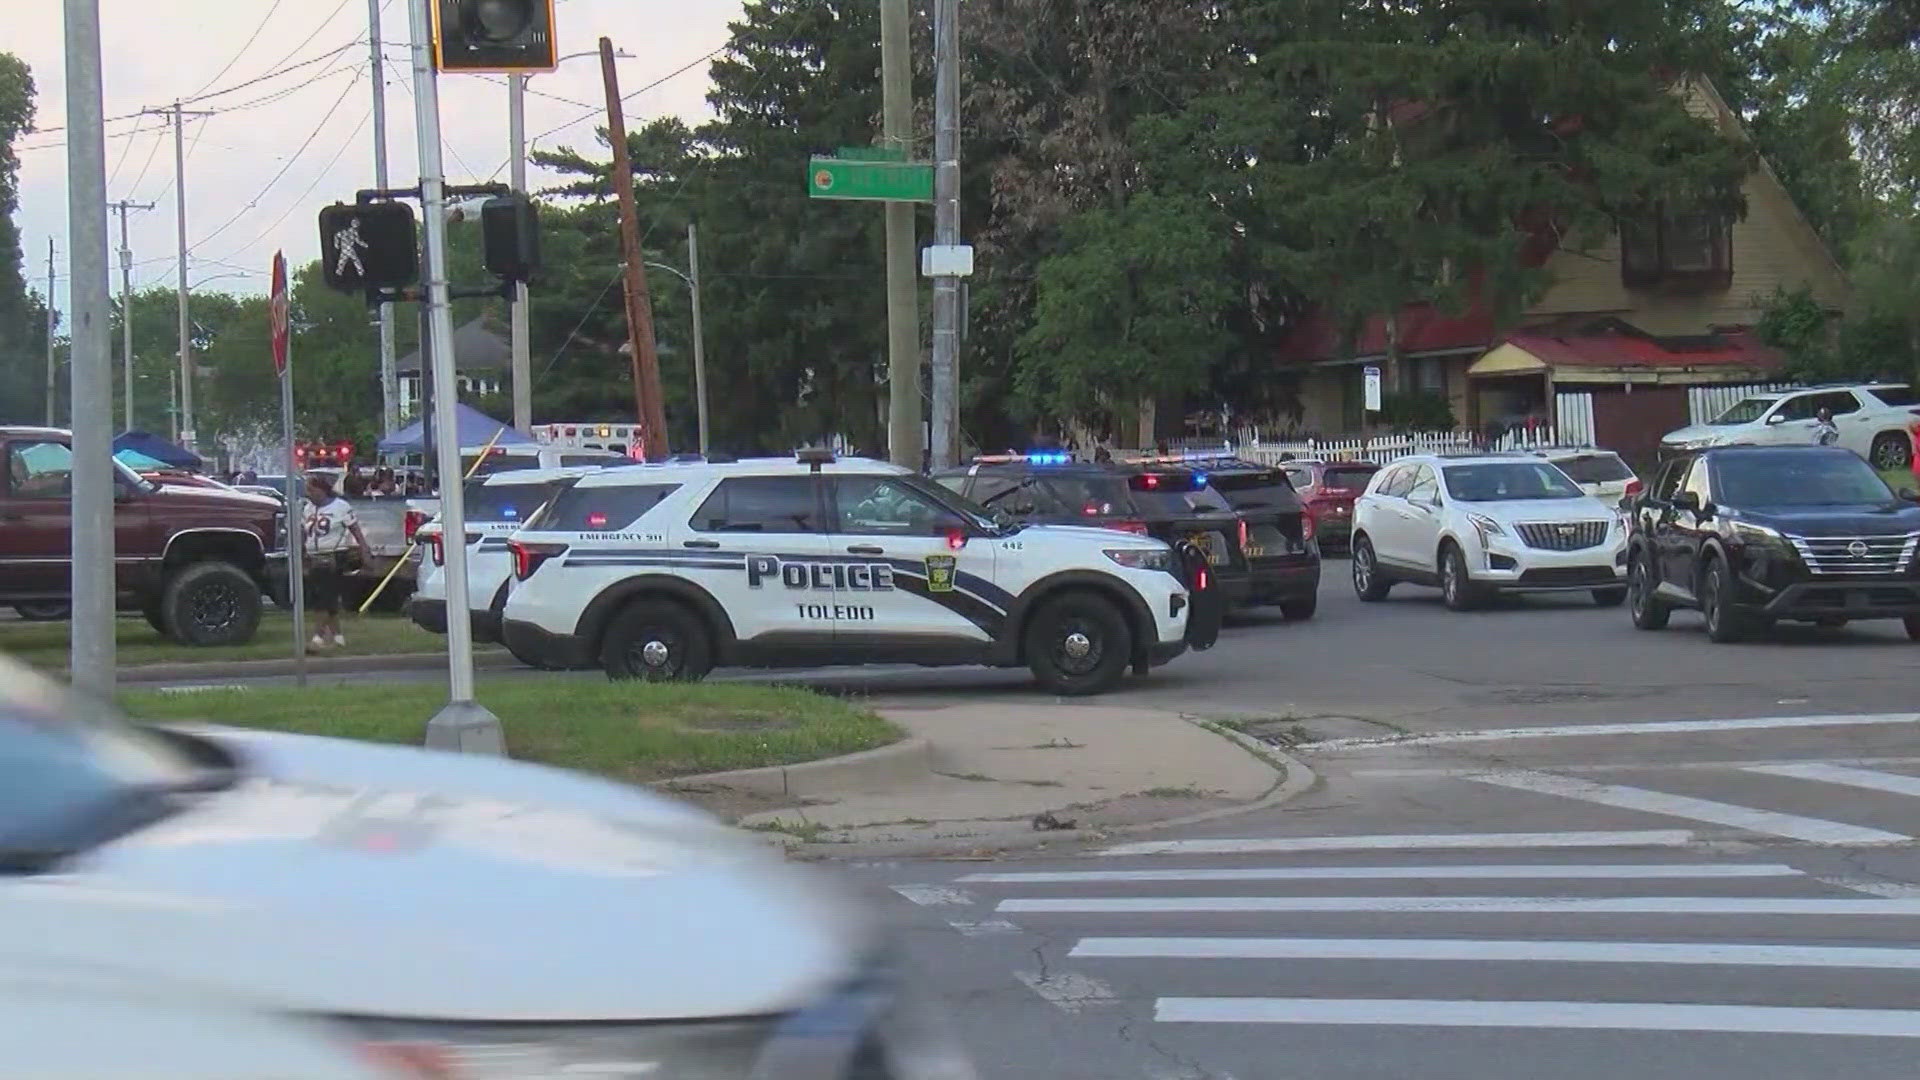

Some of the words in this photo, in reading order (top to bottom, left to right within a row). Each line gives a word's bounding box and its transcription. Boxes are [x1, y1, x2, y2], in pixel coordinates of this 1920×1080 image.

[579, 533, 642, 541] EMERGENCY
[1002, 541, 1024, 550] 442
[745, 554, 895, 592] POLICE
[797, 603, 875, 620] TOLEDO
